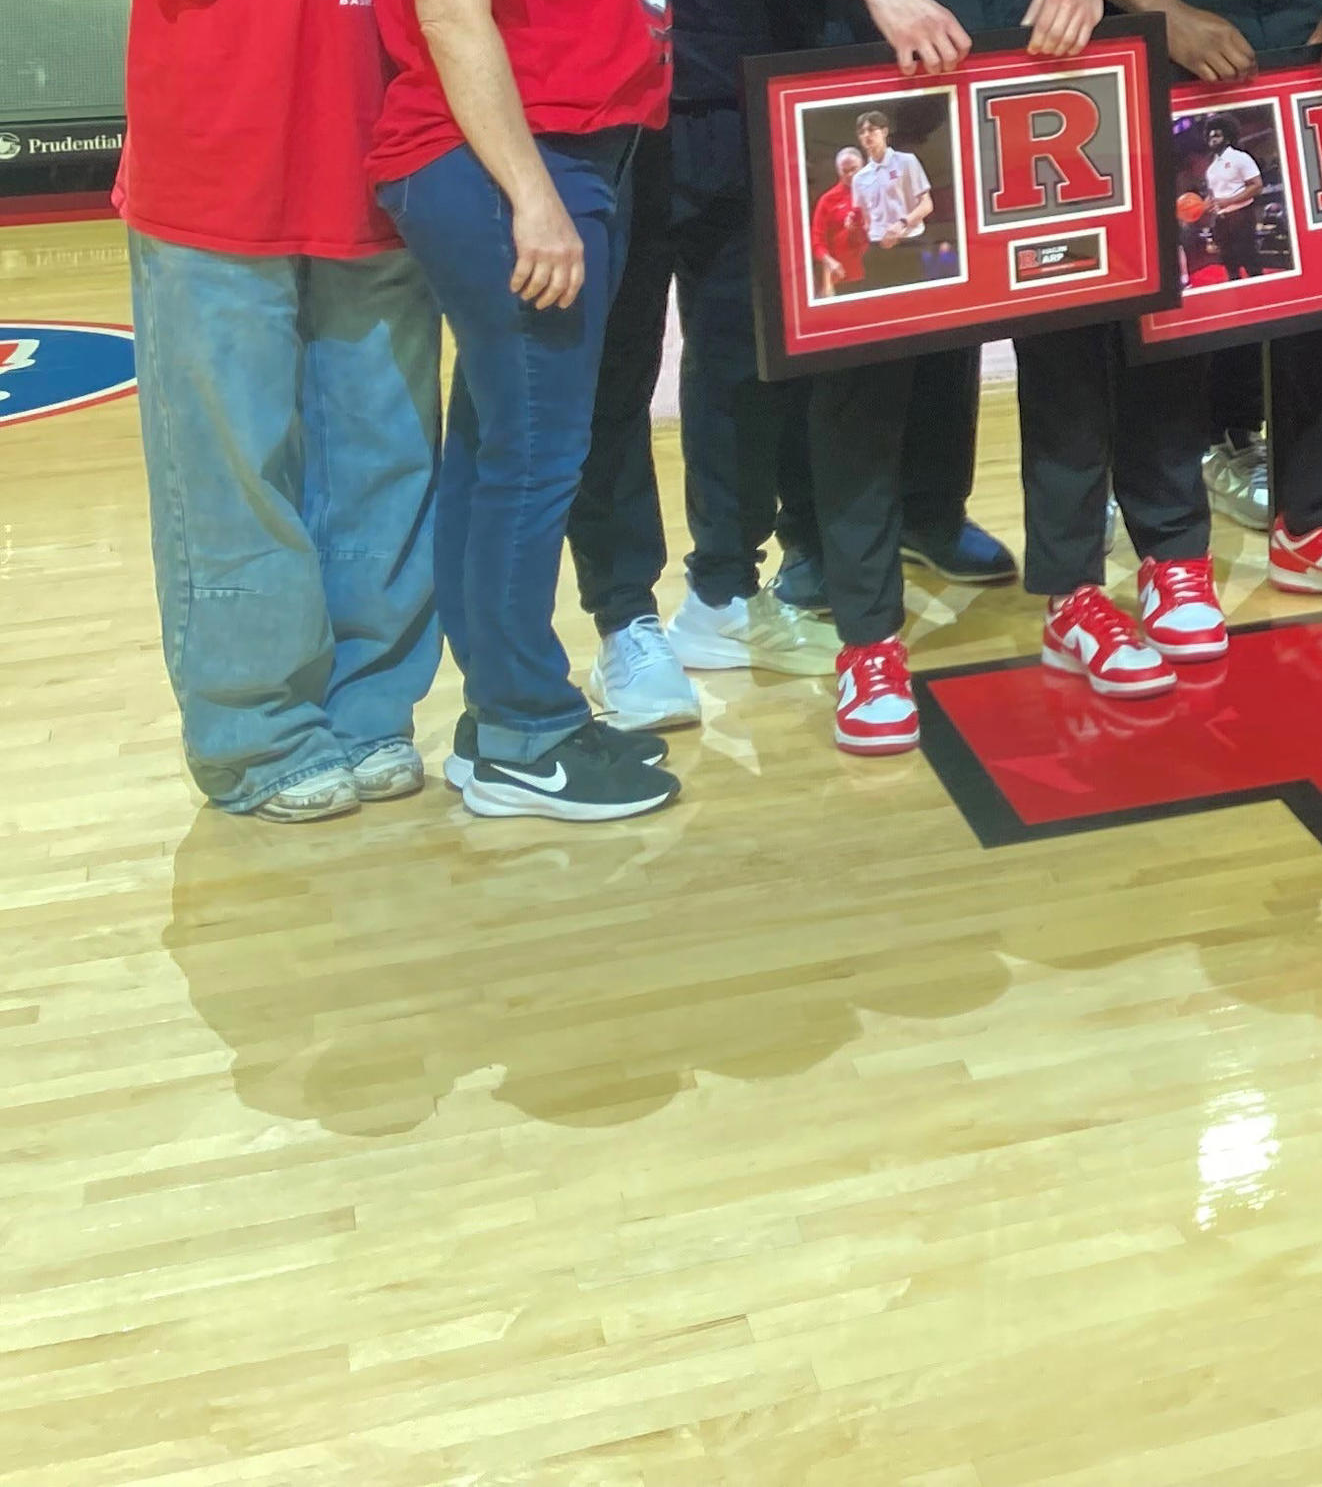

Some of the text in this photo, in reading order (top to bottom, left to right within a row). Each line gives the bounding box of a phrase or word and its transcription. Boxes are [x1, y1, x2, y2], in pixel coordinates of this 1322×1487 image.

[28, 132, 123, 155] Prudential
[986, 89, 1115, 214] R
[1042, 252, 1065, 264] ARP
